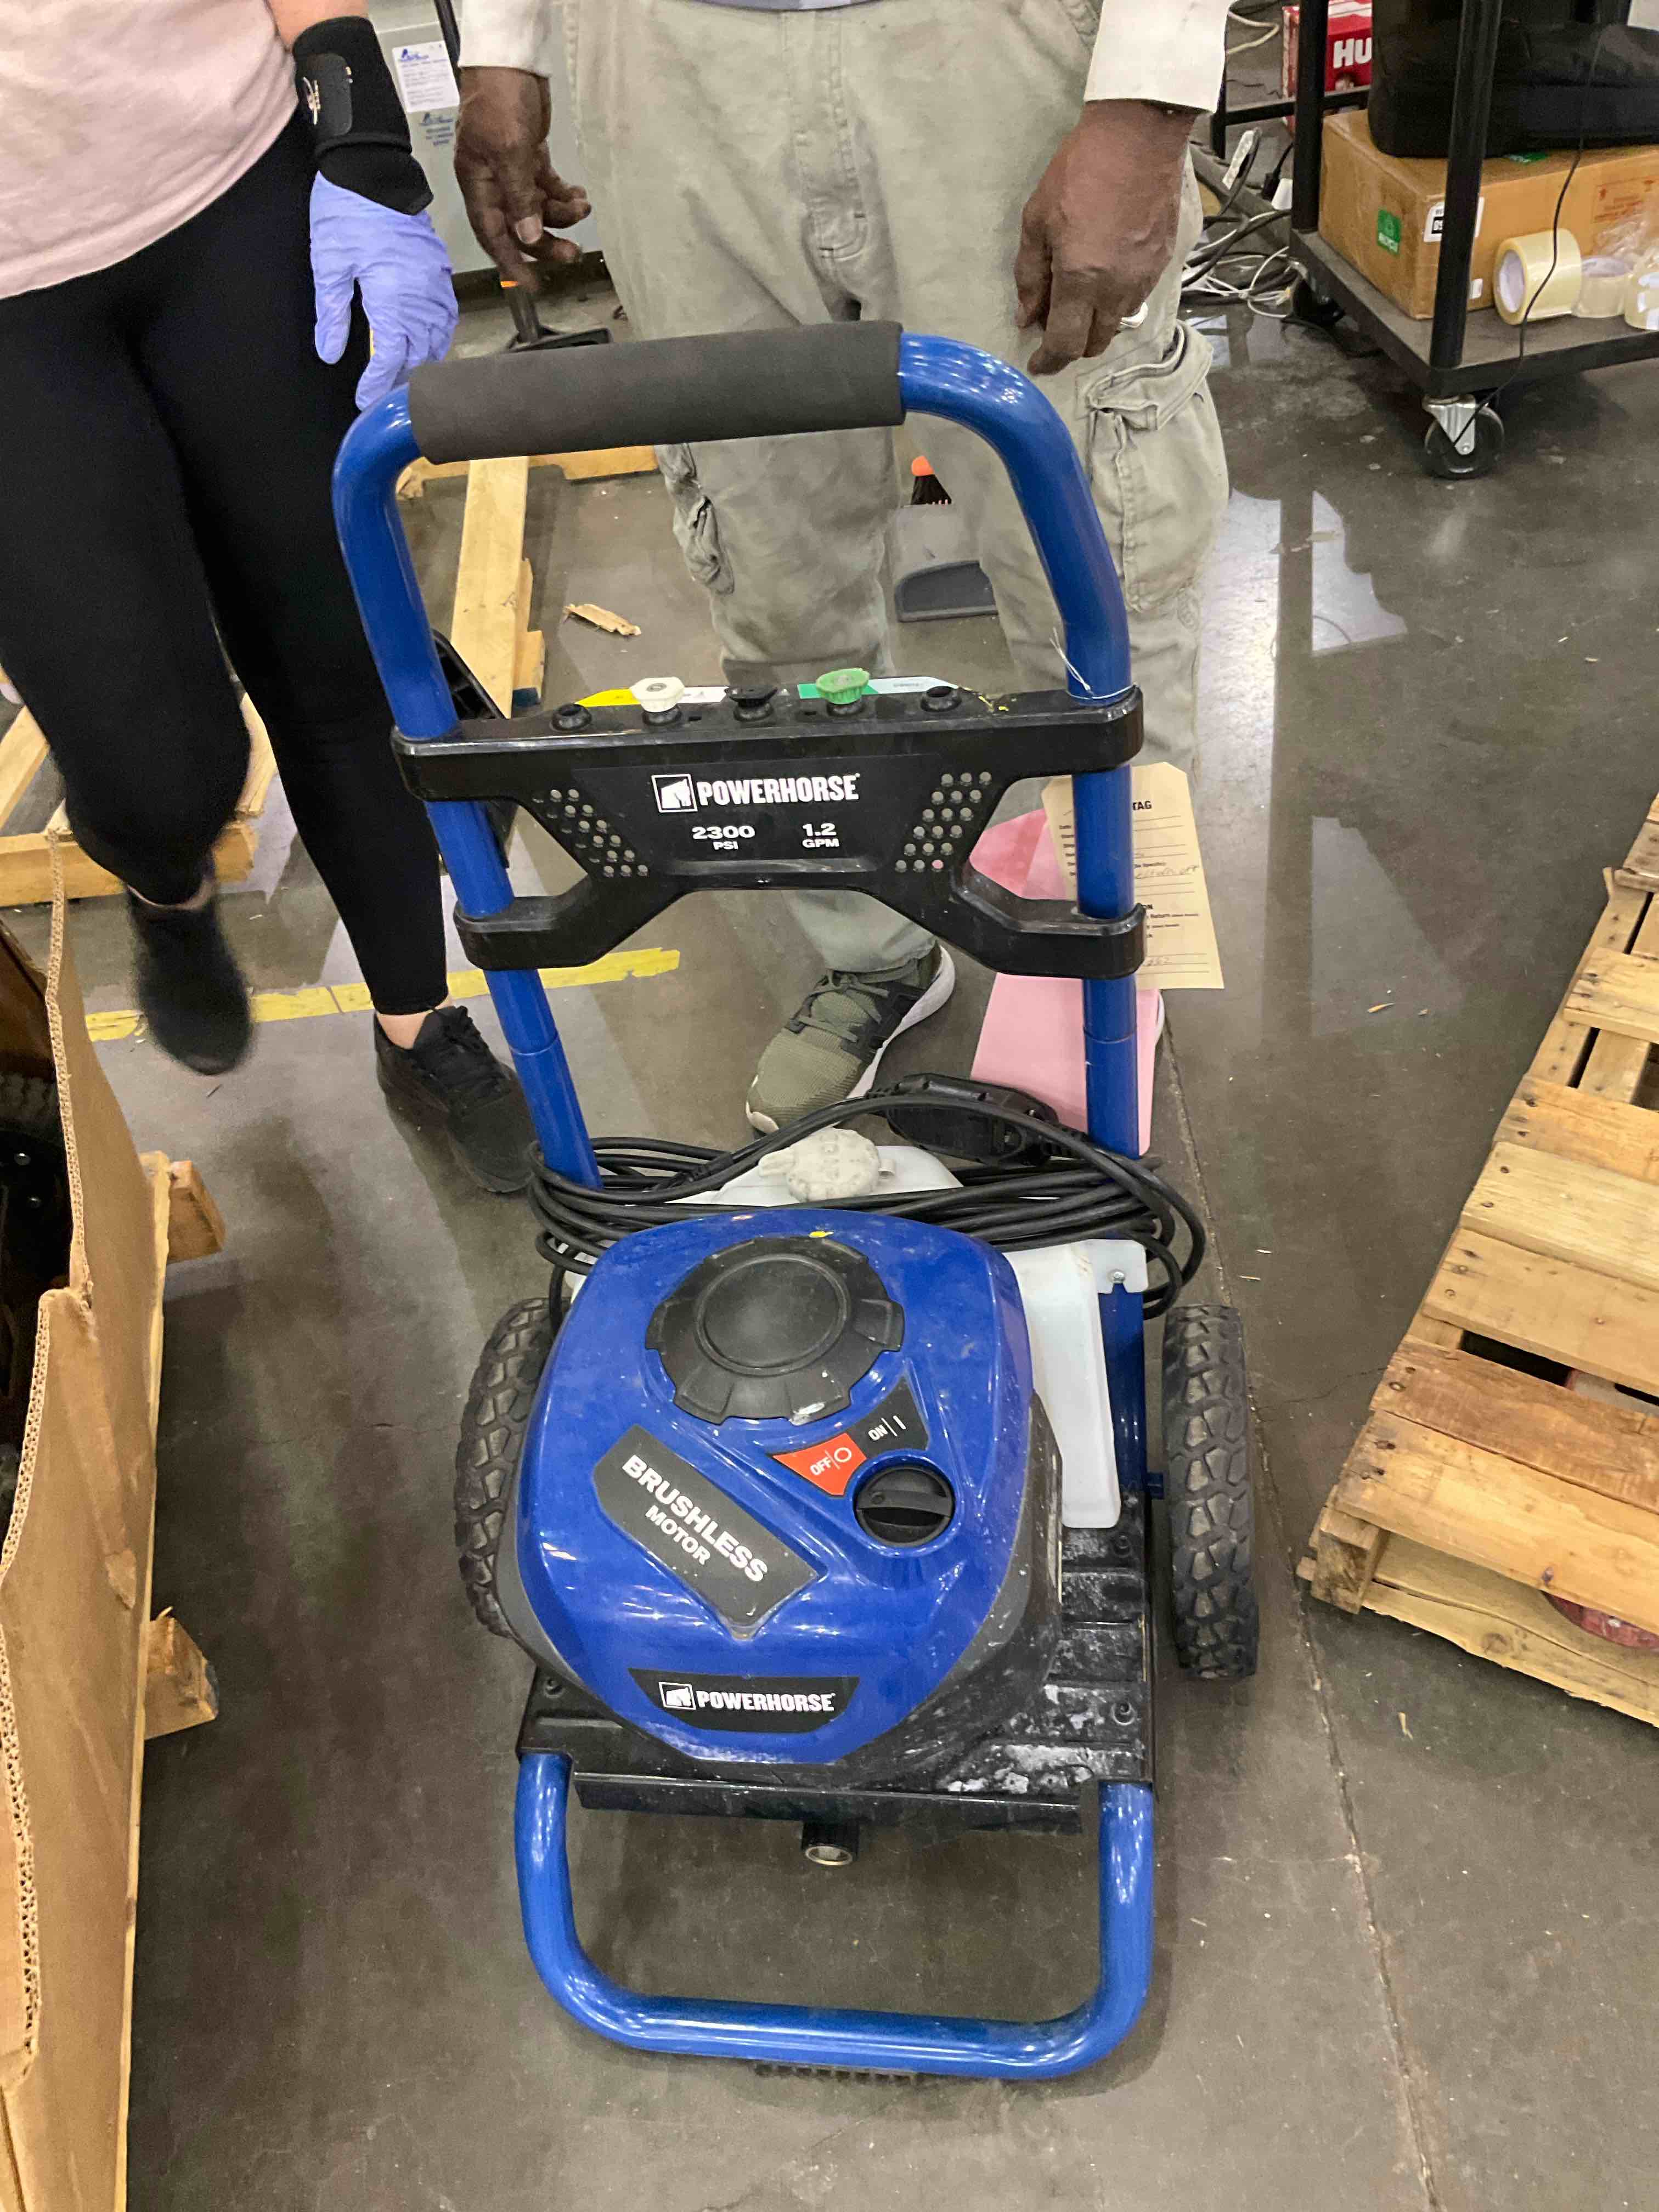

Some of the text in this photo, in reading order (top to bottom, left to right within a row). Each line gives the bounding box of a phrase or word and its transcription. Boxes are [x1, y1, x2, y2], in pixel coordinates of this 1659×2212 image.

[697, 773, 860, 805] POWERHORSE
[692, 825, 755, 839] 2300
[803, 823, 837, 837] 1.2
[713, 840, 738, 850] PSI
[802, 838, 840, 848] GPM
[868, 1424, 888, 1441] ON
[809, 1457, 832, 1476] OFF
[622, 1454, 768, 1582] BRUSHLESS
[645, 1505, 711, 1565] MOTOR
[696, 1690, 834, 1711] POWERHORSE
